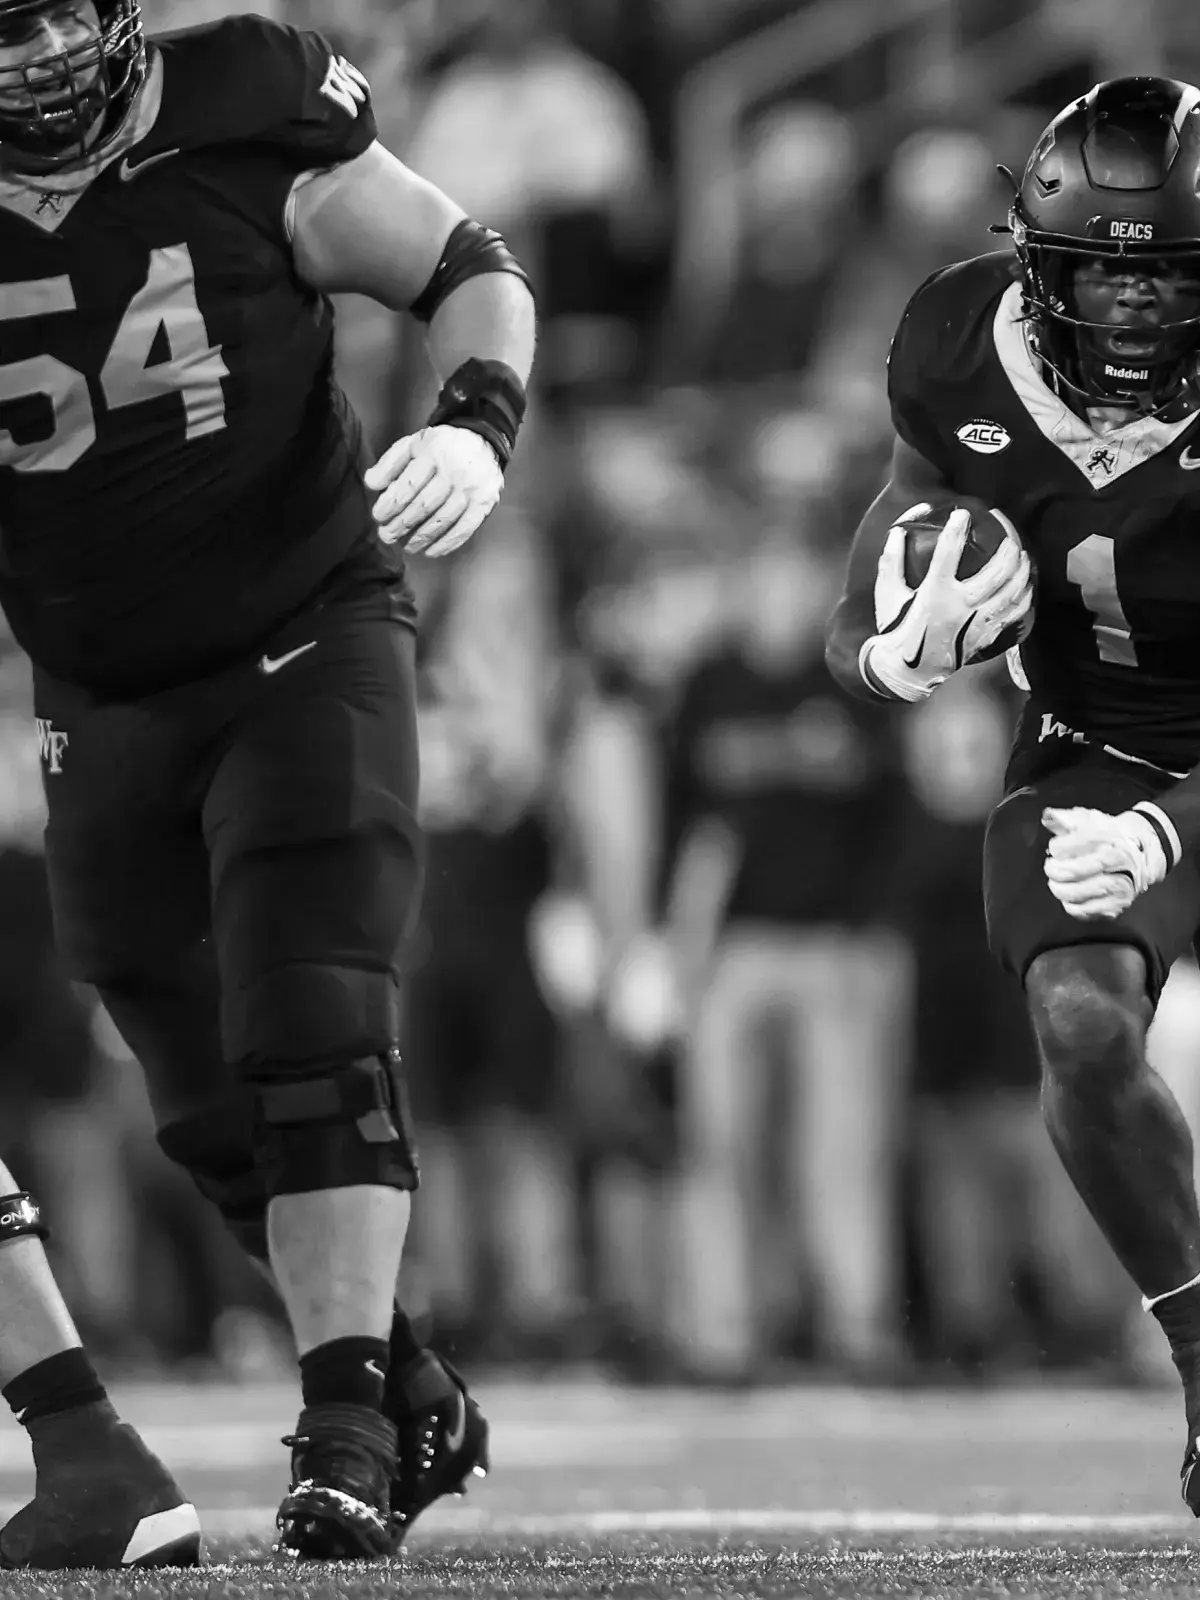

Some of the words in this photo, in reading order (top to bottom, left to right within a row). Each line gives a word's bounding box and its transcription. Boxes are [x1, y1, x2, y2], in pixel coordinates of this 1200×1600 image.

[1110, 221, 1153, 240] DEACS
[0, 242, 231, 473] 54
[1105, 364, 1149, 380] Riddell
[964, 428, 1004, 442] ACC
[1067, 534, 1138, 667] 1
